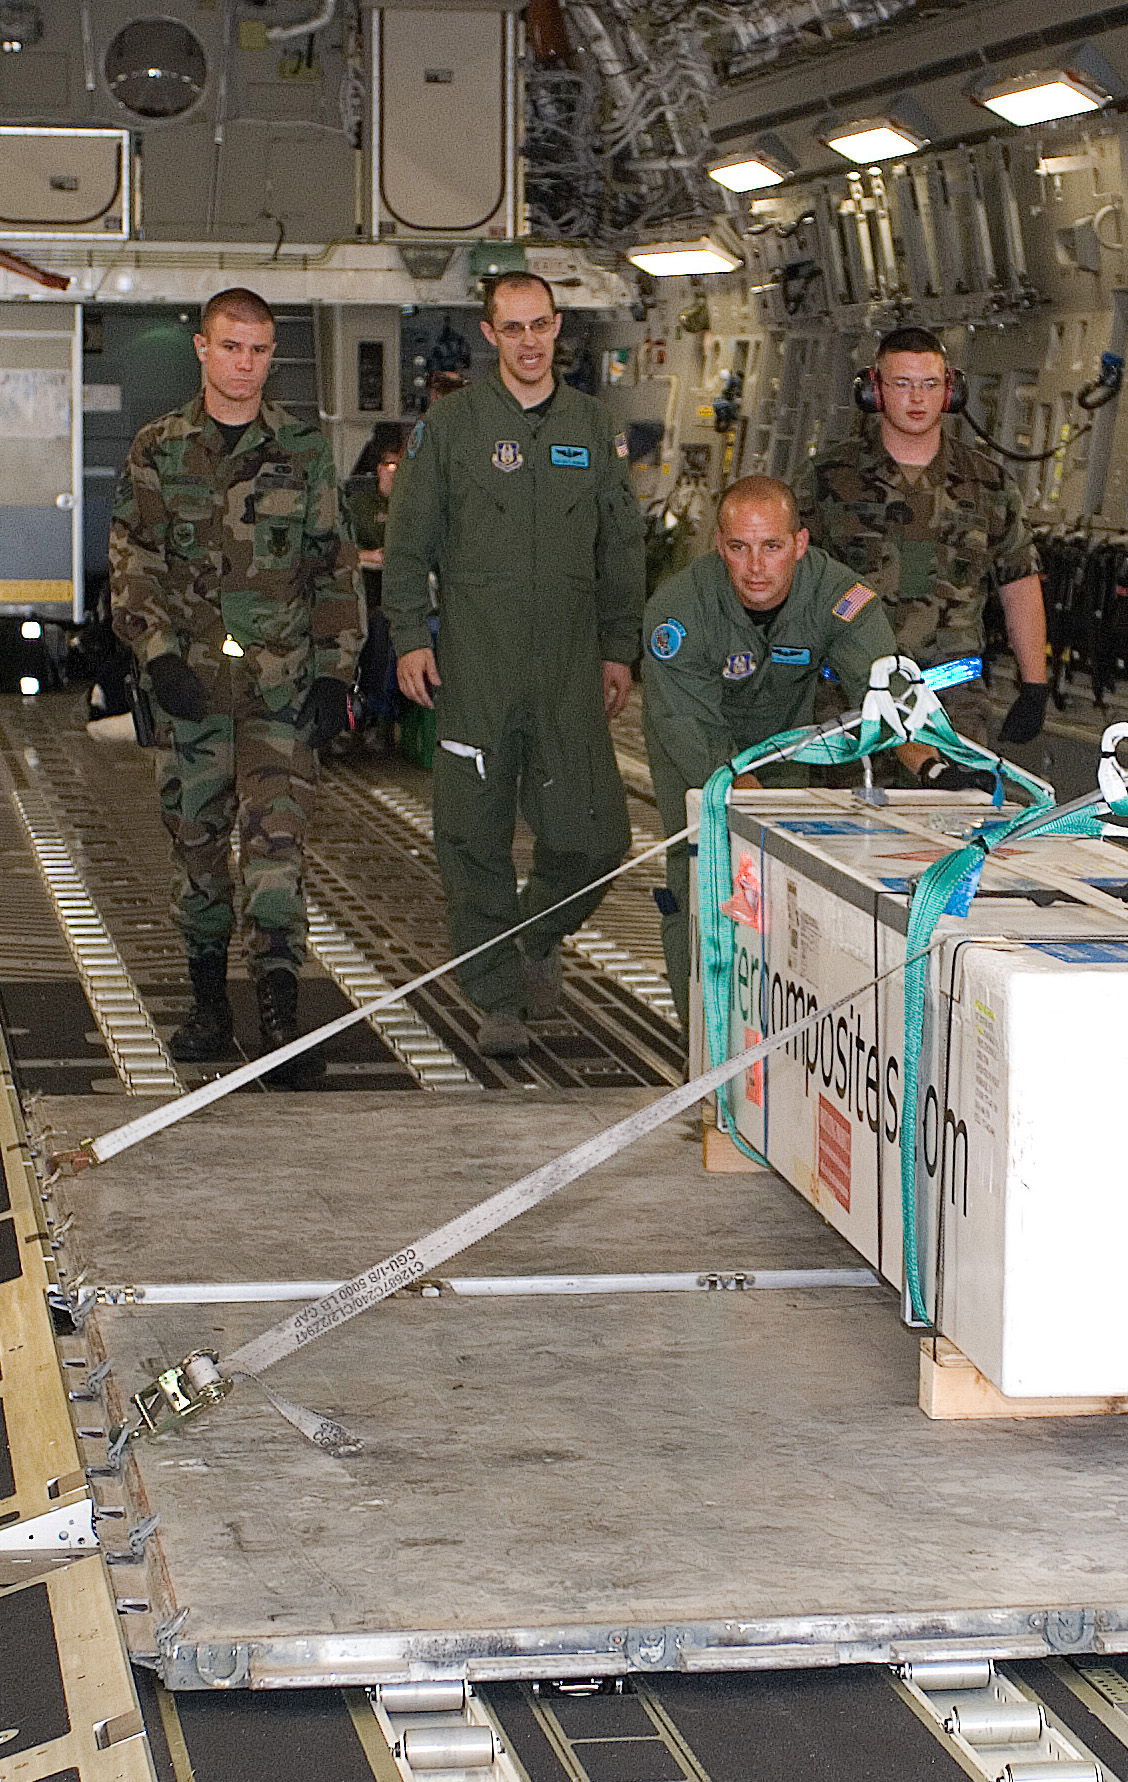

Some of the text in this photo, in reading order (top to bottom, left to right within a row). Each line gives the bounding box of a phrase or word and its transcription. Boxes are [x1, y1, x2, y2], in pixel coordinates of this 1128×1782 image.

[293, 1248, 417, 1329] CGU-1/B 5000 LB CAP
